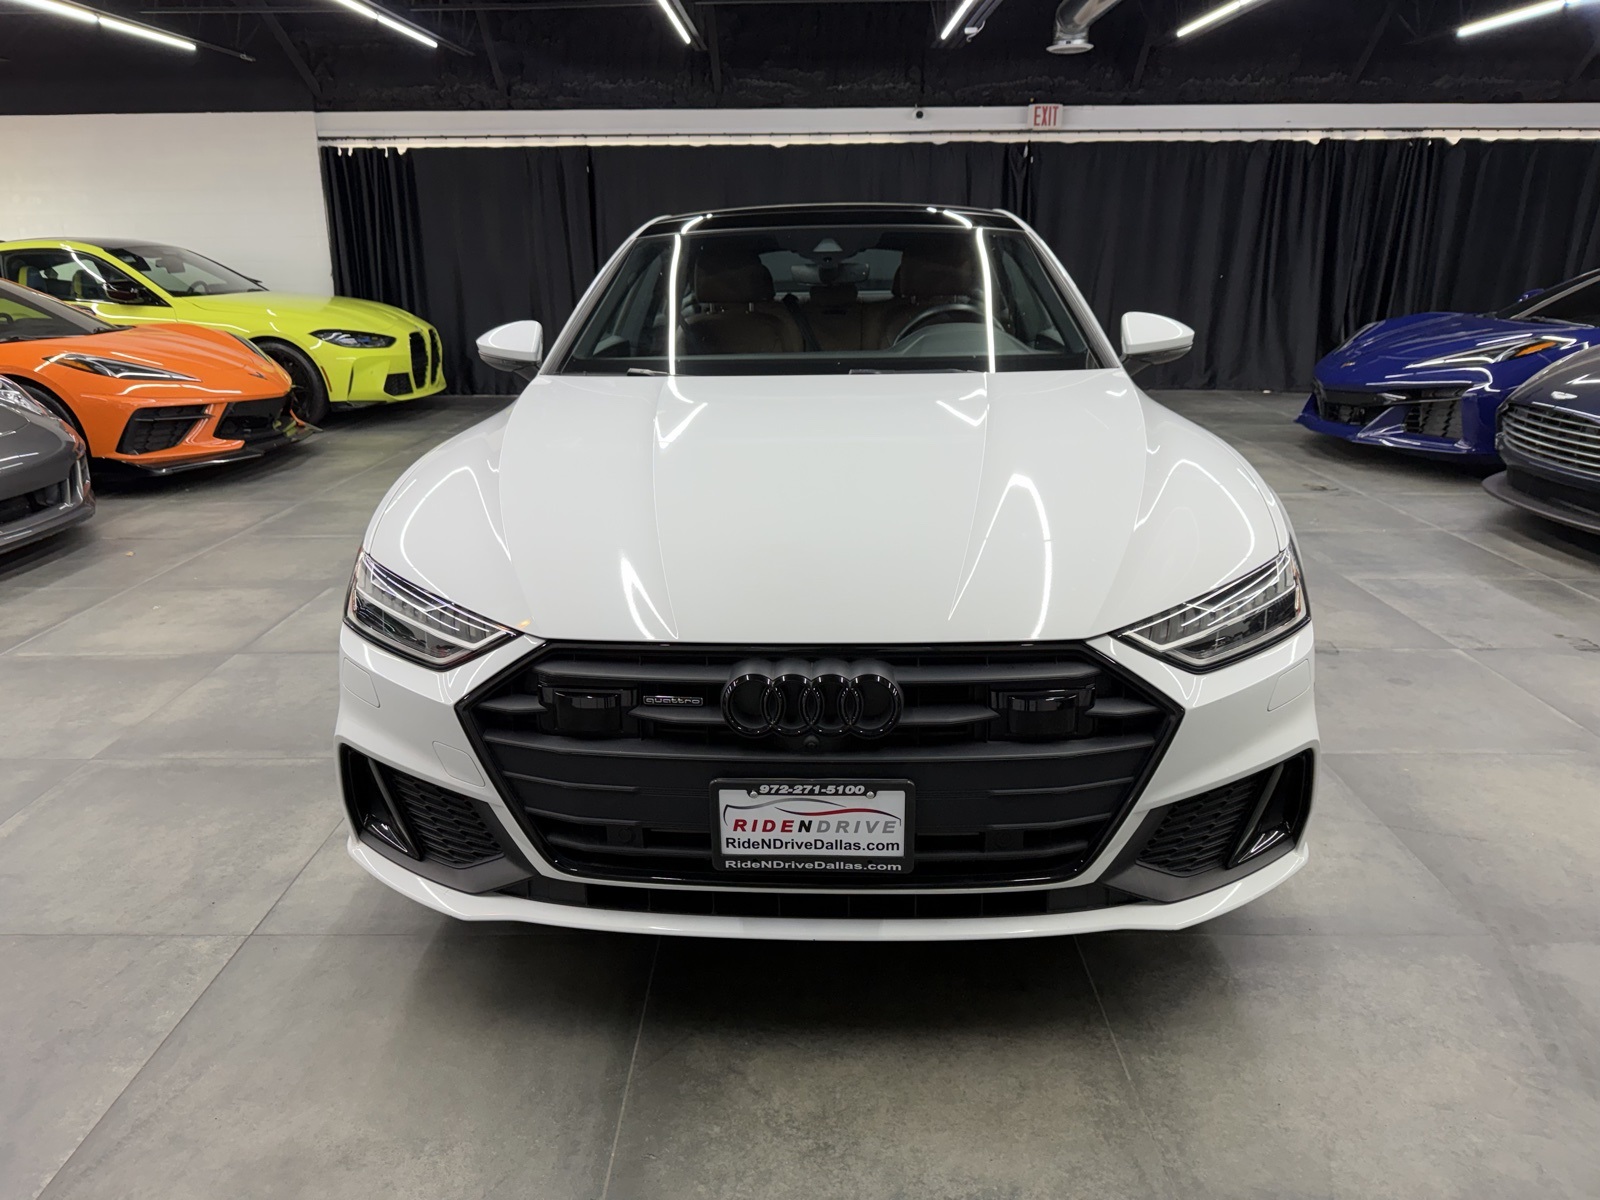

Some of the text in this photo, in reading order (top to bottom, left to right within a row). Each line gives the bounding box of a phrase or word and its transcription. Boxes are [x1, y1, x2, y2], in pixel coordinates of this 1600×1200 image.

[1034, 106, 1059, 126] EXIT
[759, 785, 865, 795] 972-271-5100
[725, 837, 900, 851] RideNDriveDallas.com
[725, 860, 902, 871] RideNDriveDallas.com
